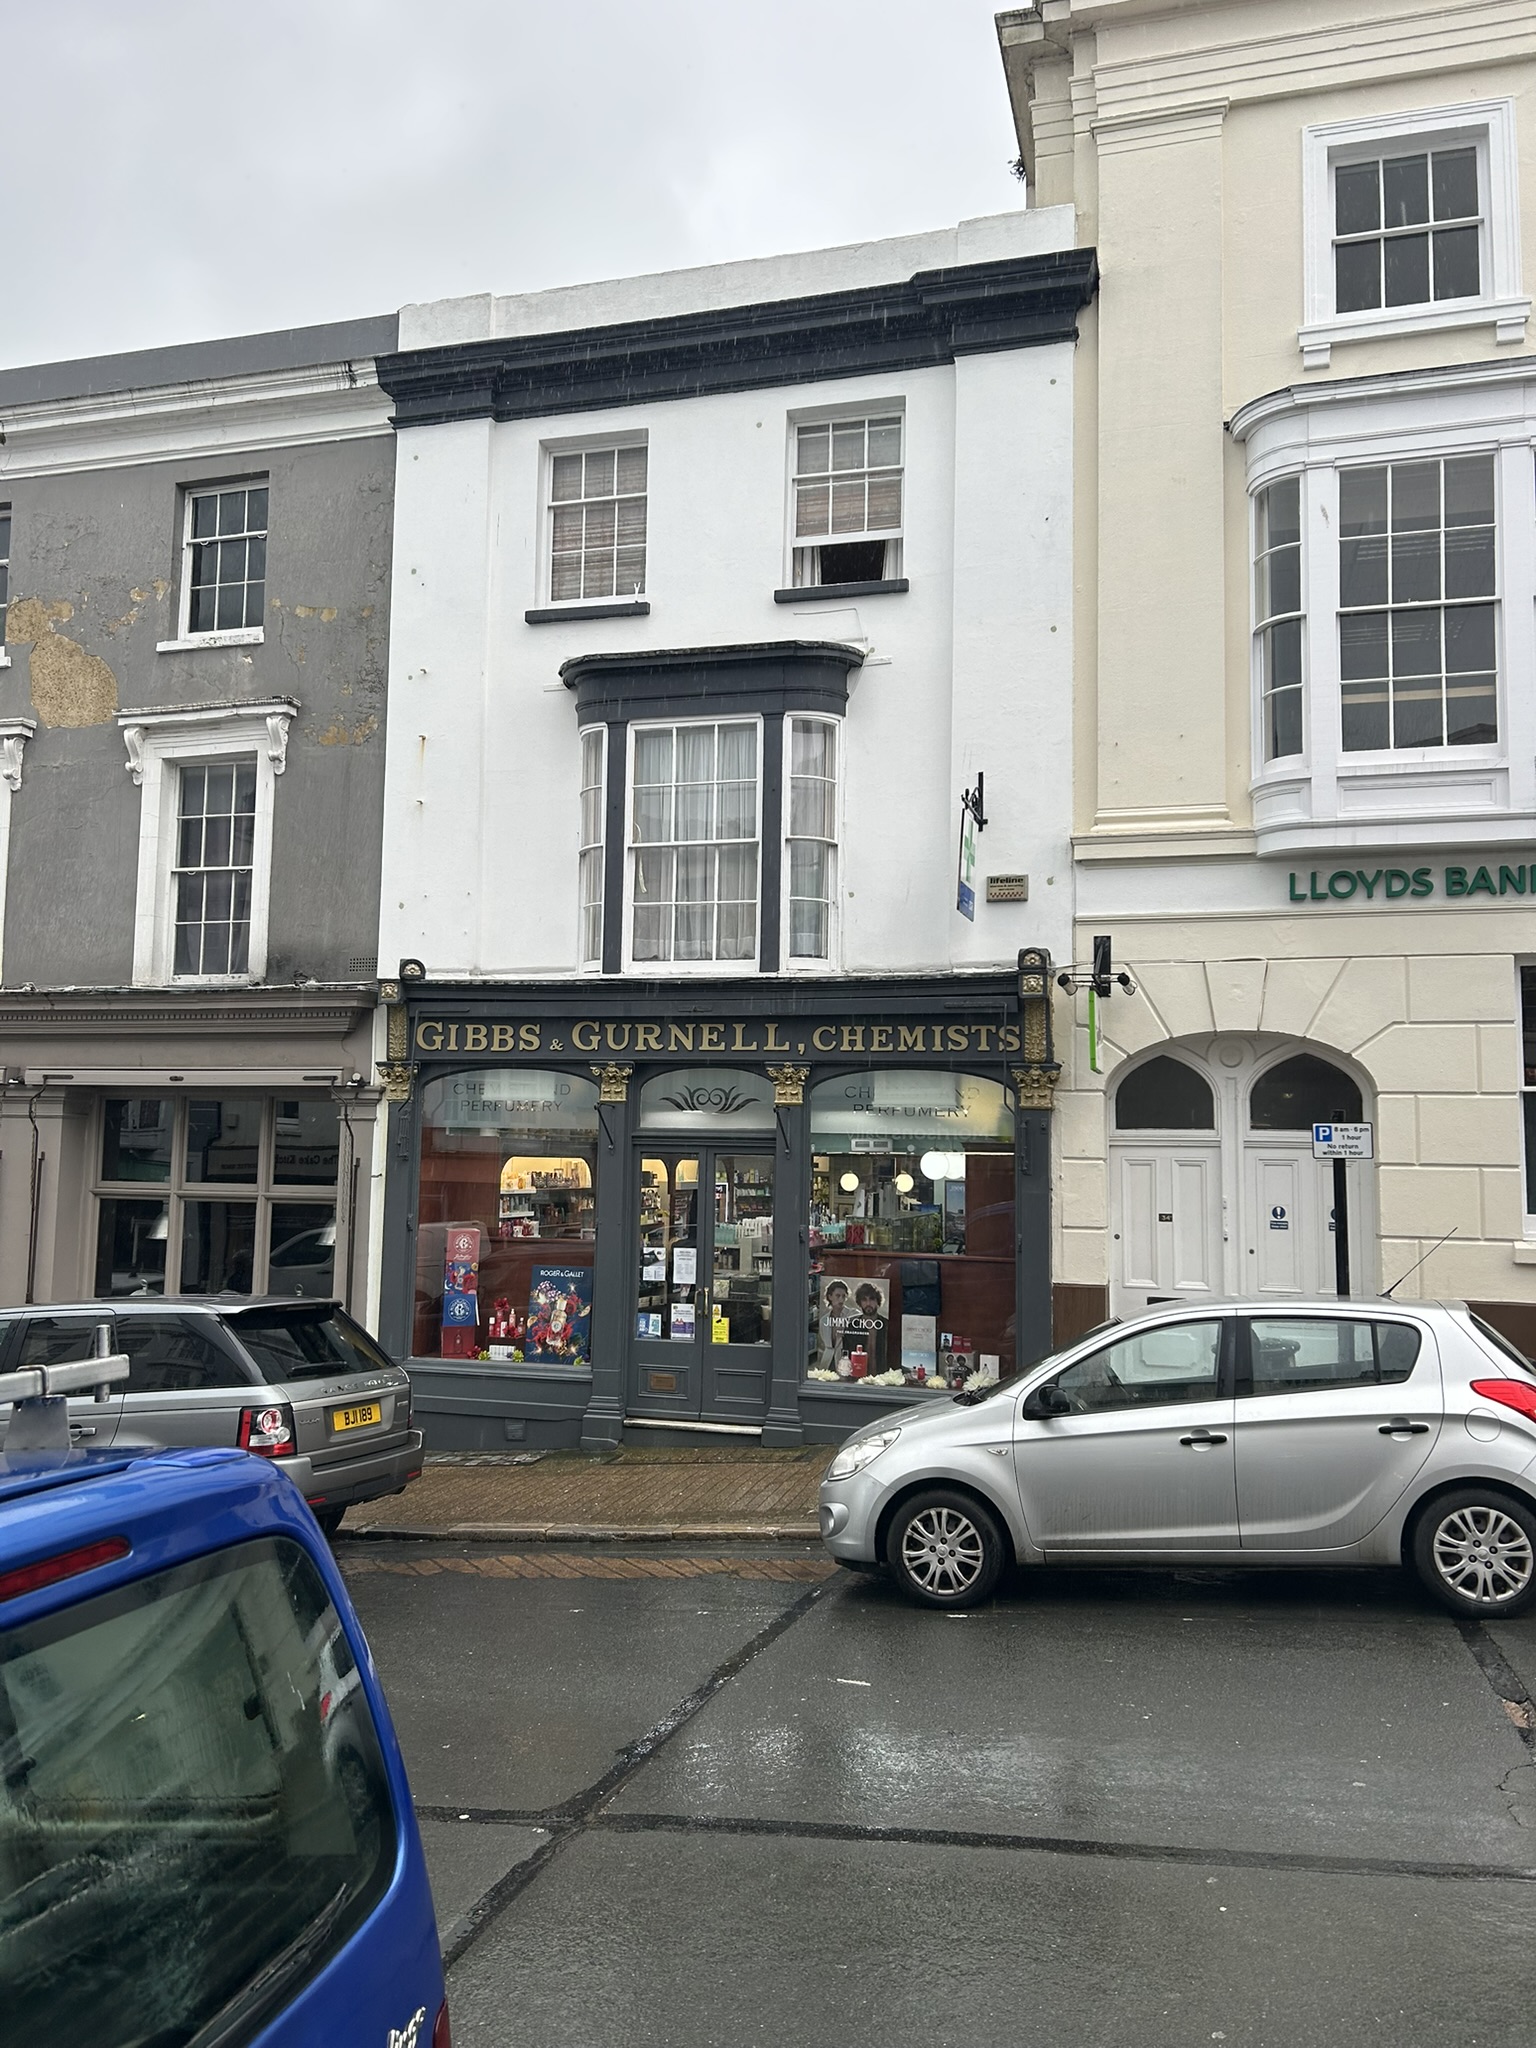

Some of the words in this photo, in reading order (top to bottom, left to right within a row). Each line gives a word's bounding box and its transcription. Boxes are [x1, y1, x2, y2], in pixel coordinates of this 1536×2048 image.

[1289, 867, 1434, 901] LLOYDS
[1446, 864, 1536, 896] BAN
[416, 1021, 542, 1052] GIBBS
[549, 1039, 564, 1051] &
[571, 1021, 805, 1056] GURNELL,
[812, 1024, 1021, 1052] CHEMISTS
[460, 1100, 563, 1112] PERFUMERY
[853, 1104, 971, 1118] PERFUMERY
[1319, 1127, 1330, 1140] P
[564, 1270, 585, 1278] GALLET
[823, 1317, 851, 1328] JIMMY
[852, 1318, 884, 1330] CHOO
